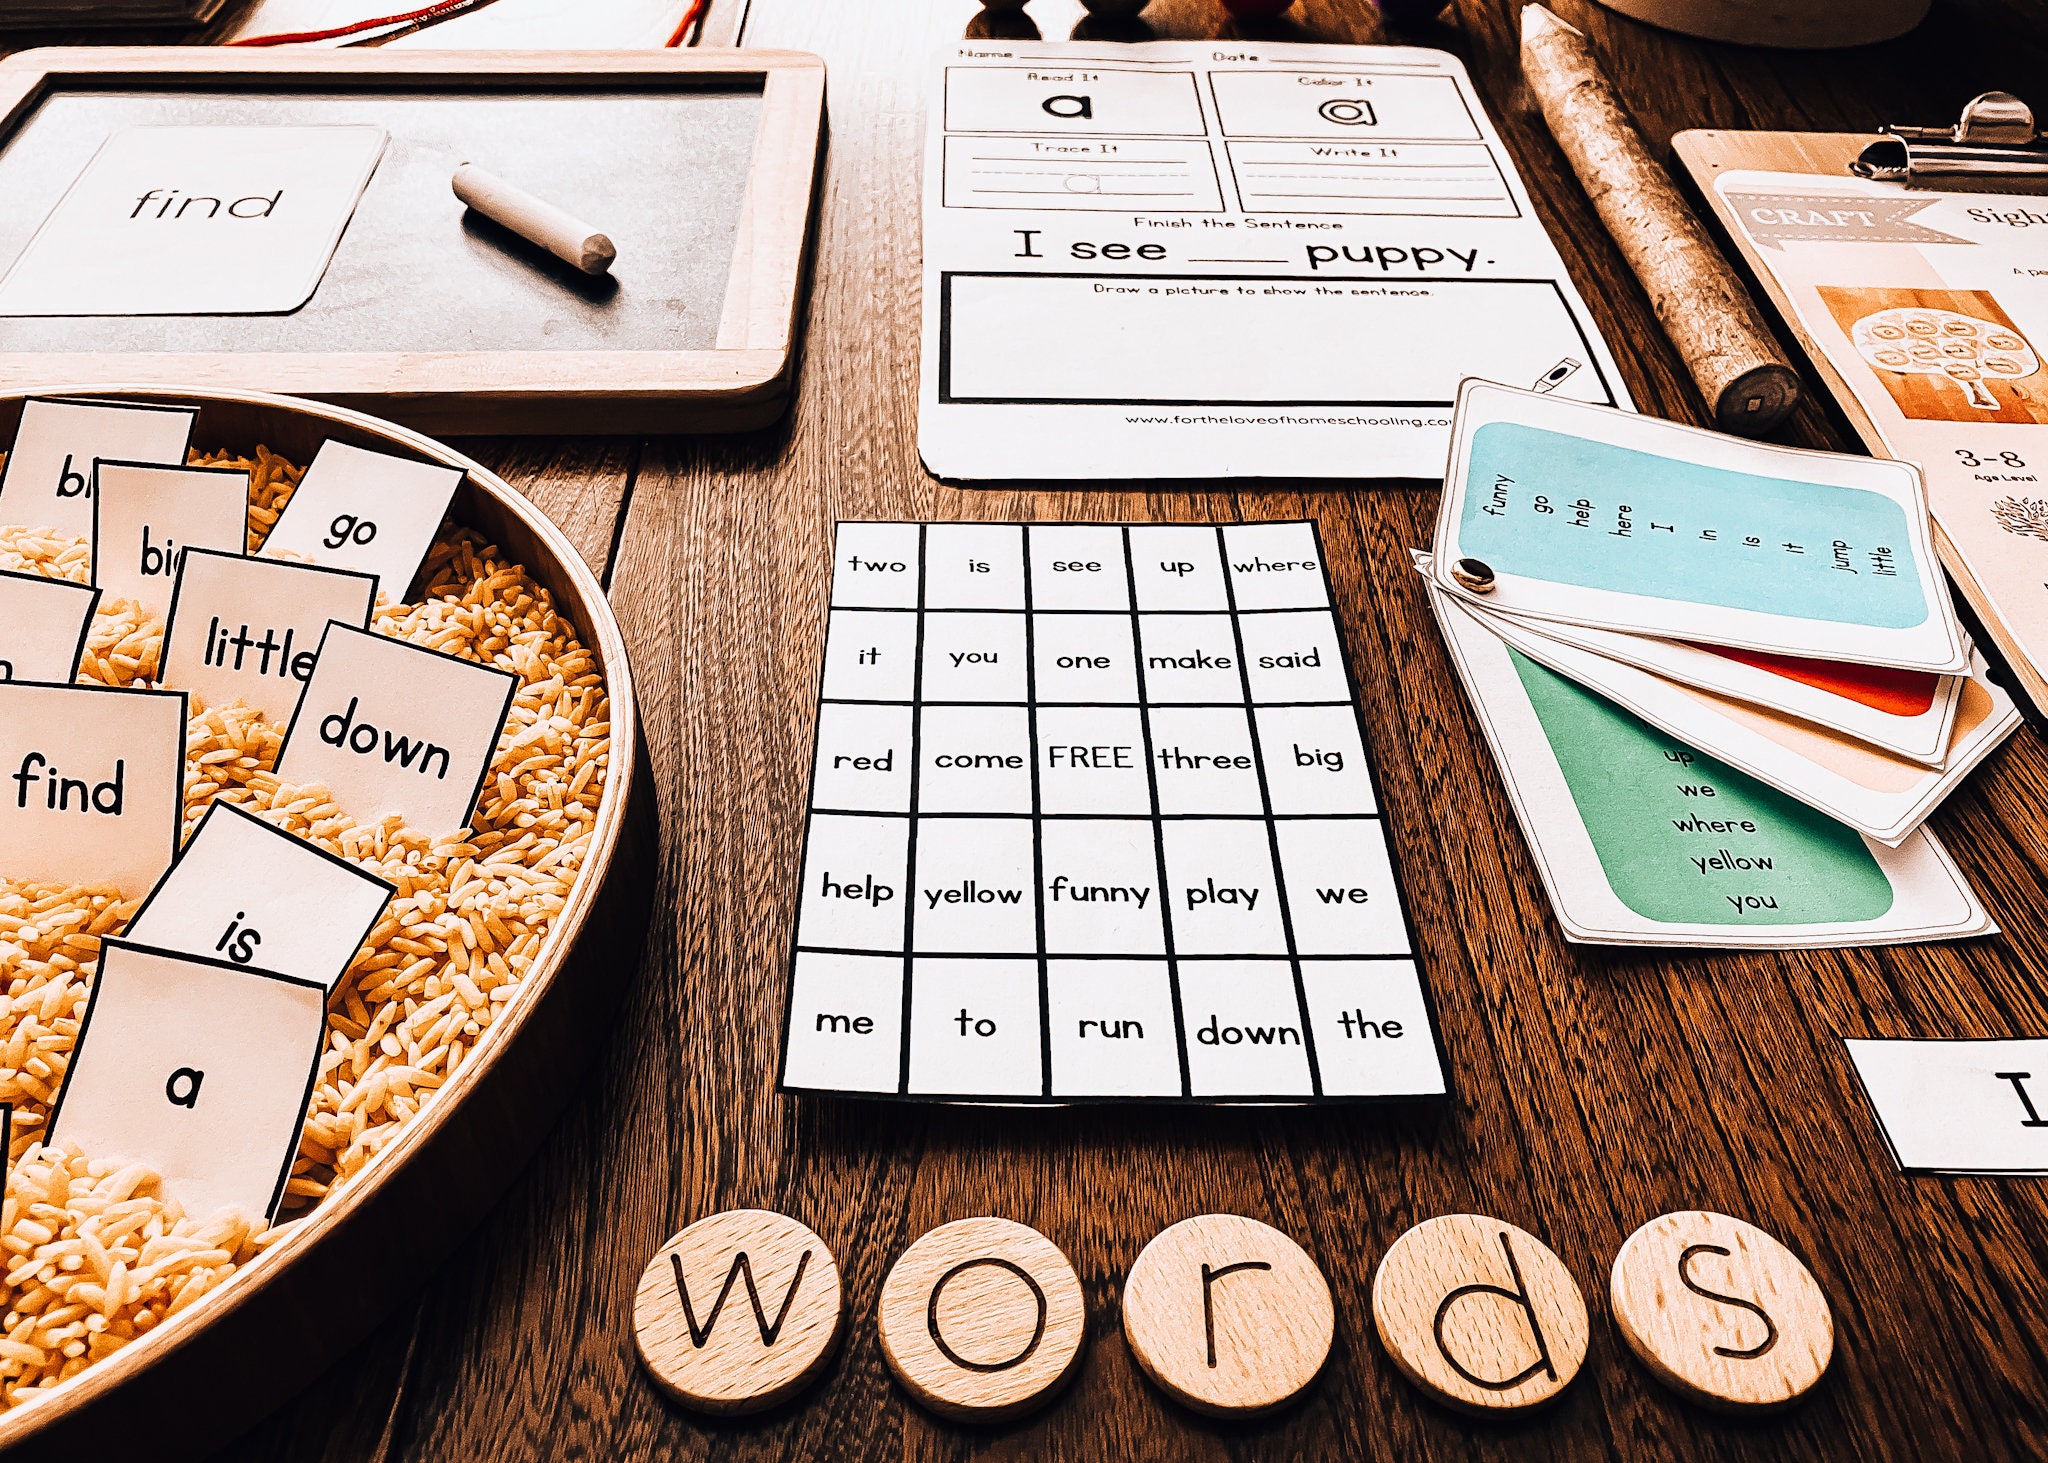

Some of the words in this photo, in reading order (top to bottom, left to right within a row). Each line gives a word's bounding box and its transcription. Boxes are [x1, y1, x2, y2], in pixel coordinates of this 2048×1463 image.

[958, 48, 1014, 59] Name
[1212, 51, 1259, 62] Date
[1041, 94, 1093, 120] a
[1318, 98, 1378, 127] a
[1033, 143, 1090, 153] Trace
[1100, 144, 1118, 153] It
[1310, 147, 1370, 156] Write
[1380, 148, 1398, 157] It
[129, 189, 284, 219] find
[1133, 217, 1192, 229] Finish
[1202, 218, 1237, 229] the
[1245, 218, 1342, 230] Sentence
[1750, 207, 1876, 227] CRAFT
[1966, 208, 2048, 228] Sigh
[1013, 229, 1044, 258] I
[1070, 241, 1167, 261] see
[1305, 244, 1496, 273] puppy.
[1094, 284, 1140, 294] Draw
[1166, 286, 1228, 298] picture
[1237, 287, 1255, 295] to
[1263, 288, 1306, 296] show
[1314, 288, 1343, 296] the
[1351, 289, 1434, 297] sentence.
[1125, 415, 1452, 428] www.fortheloveofhomeschooling.co
[1954, 449, 2026, 469] 3-8
[1975, 474, 1999, 482] Age
[1482, 473, 1516, 516] funny
[1534, 495, 1554, 515] go
[1566, 499, 1595, 528] help
[1608, 505, 1633, 538] here
[322, 514, 377, 550] go
[1650, 522, 1674, 533] I
[1699, 529, 1717, 541] in
[141, 525, 181, 577] bi
[1742, 536, 1761, 548] is
[1781, 542, 1805, 554] it
[847, 555, 907, 573] two
[969, 562, 991, 573] is
[1052, 561, 1102, 572] see
[1233, 555, 1318, 576] where
[1832, 540, 1858, 575] jump
[1870, 547, 1896, 576] little
[1160, 561, 1195, 578] up
[204, 616, 317, 682] little
[859, 647, 882, 665] it
[949, 652, 998, 668] you
[1147, 649, 1233, 672] make
[1259, 646, 1321, 669] said
[1056, 656, 1111, 669] one
[319, 696, 450, 780] down
[833, 748, 893, 772] red
[931, 746, 1026, 771] come
[1049, 745, 1134, 769] FREE
[1156, 747, 1252, 772] three
[1293, 743, 1344, 772] big
[1663, 750, 1694, 768] up
[11, 751, 125, 816] find
[1676, 777, 1720, 797] we
[1672, 812, 1757, 833] where
[1690, 849, 1773, 875] yellow
[821, 871, 894, 908] help
[923, 880, 1023, 910] yellow
[1048, 875, 1151, 910] funny
[1186, 878, 1259, 911] play
[1315, 888, 1369, 904] we
[1726, 895, 1779, 915] you
[215, 911, 261, 963] is
[815, 1013, 874, 1035] me
[953, 1008, 997, 1038] to
[1078, 1019, 1144, 1039] run
[1193, 1012, 1301, 1049] down
[1336, 1008, 1404, 1039] the
[165, 1067, 205, 1109] a
[1995, 1071, 2048, 1127] I
